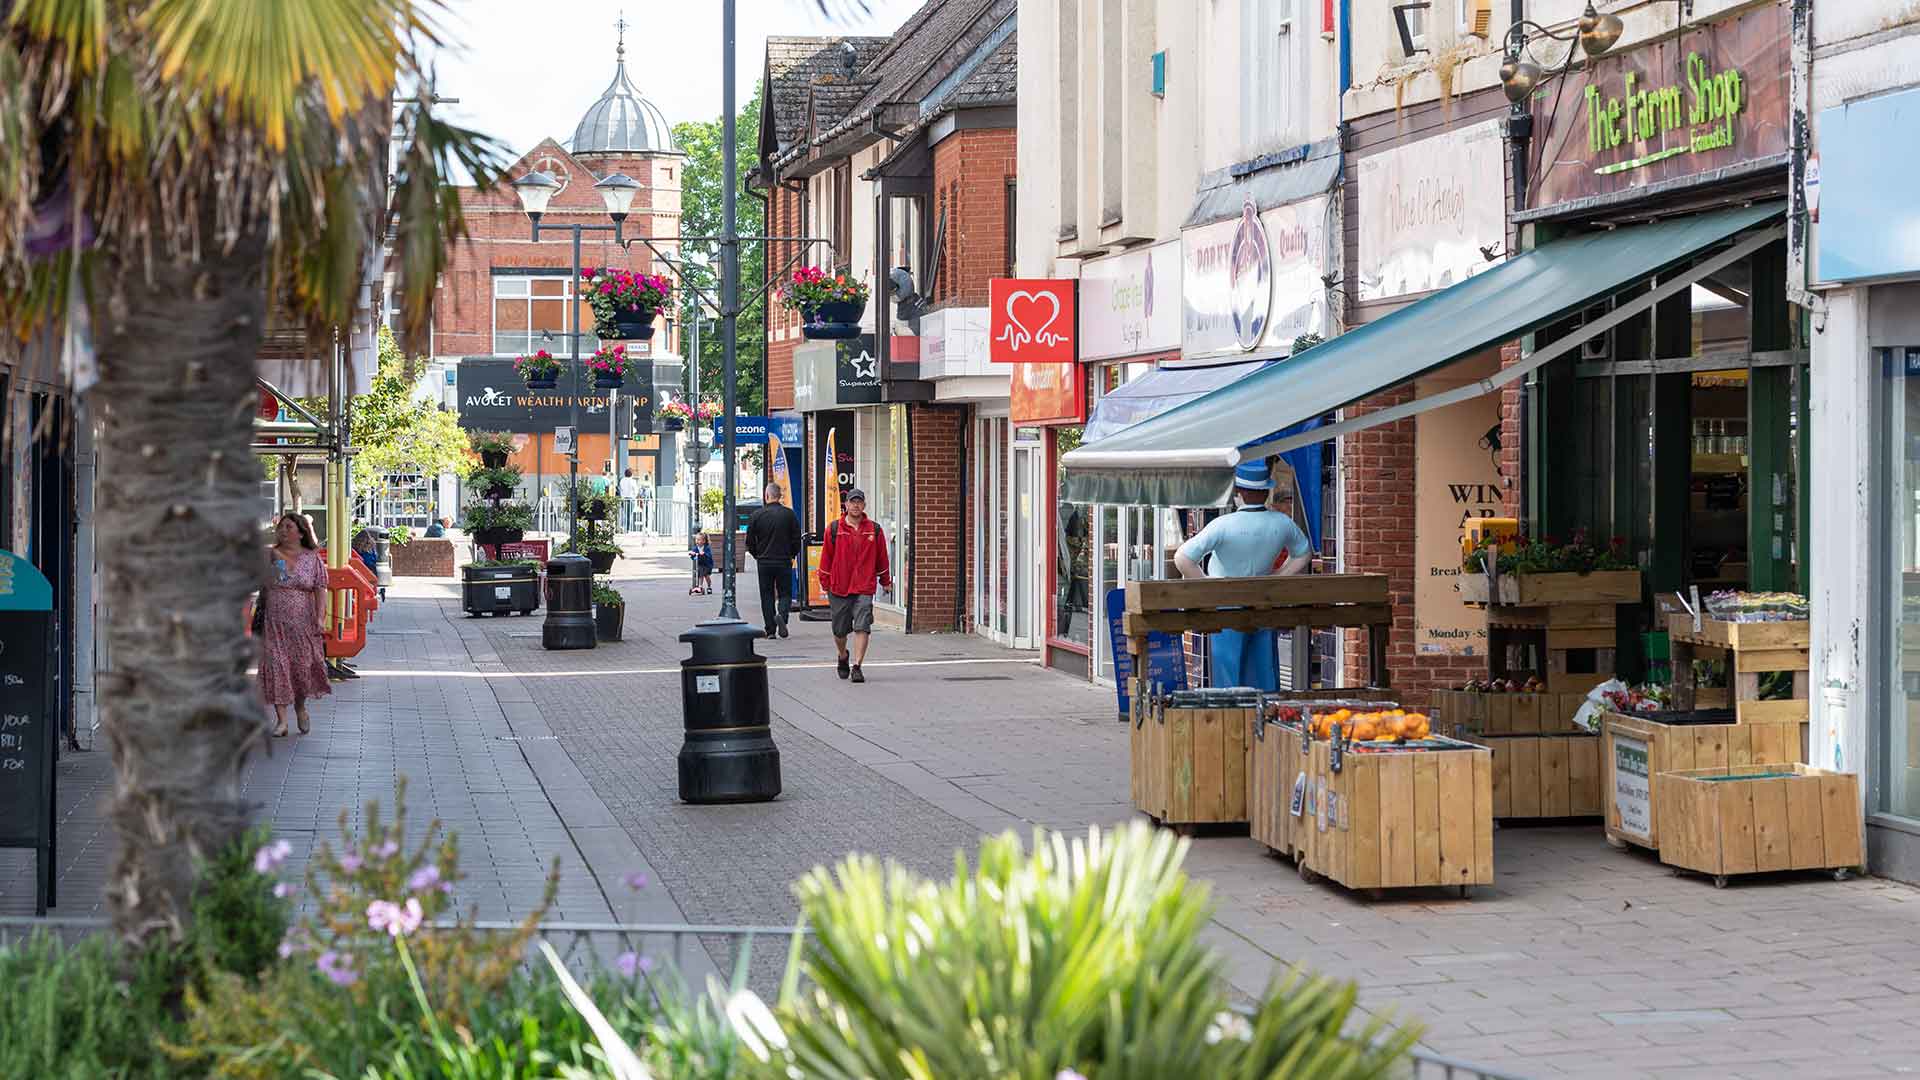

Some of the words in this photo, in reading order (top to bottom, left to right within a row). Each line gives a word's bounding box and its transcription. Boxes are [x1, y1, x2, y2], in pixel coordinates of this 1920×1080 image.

[1584, 84, 1621, 152] The
[1625, 71, 1681, 143] Farm
[1687, 51, 1742, 145] Shop
[465, 395, 513, 407] AVOCET
[517, 396, 564, 407] WEALTH
[717, 425, 766, 434] sezone
[1428, 627, 1471, 641] Monday
